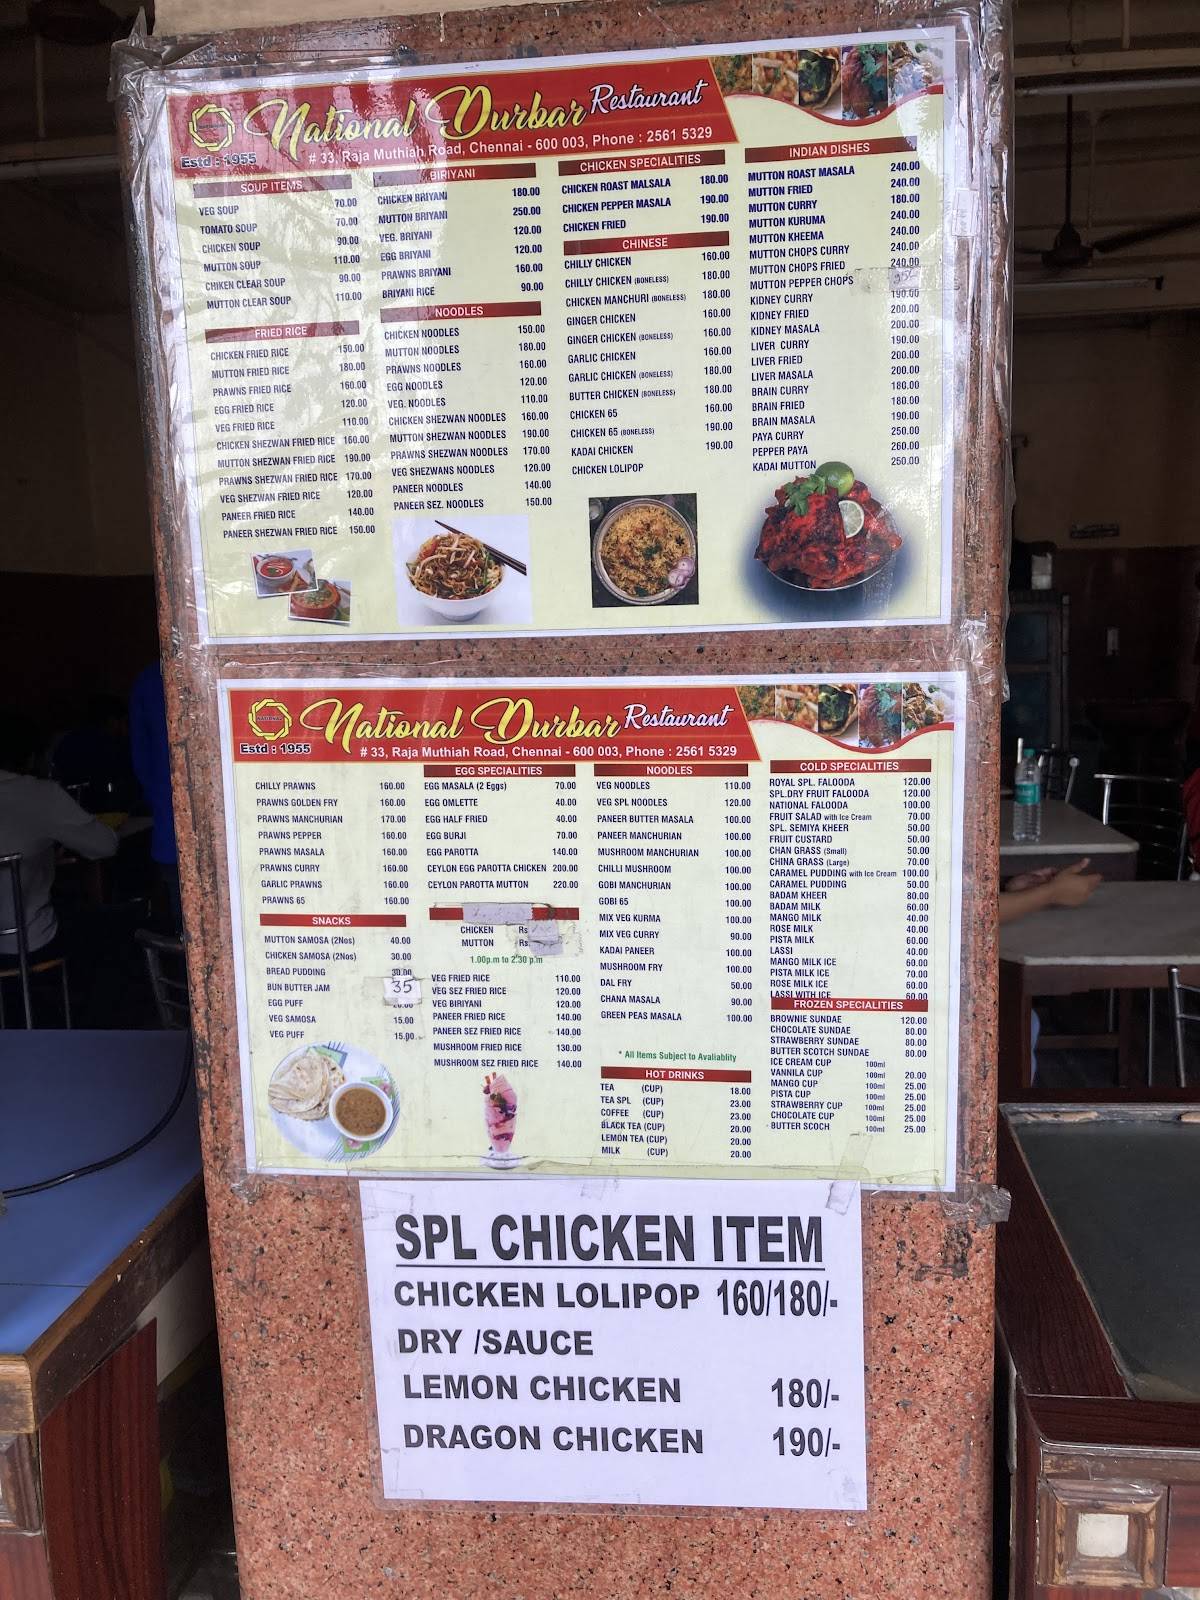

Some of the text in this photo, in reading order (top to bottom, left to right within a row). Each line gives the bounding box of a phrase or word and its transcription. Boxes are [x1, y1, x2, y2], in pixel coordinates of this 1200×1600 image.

[244, 79, 708, 162] National Durbar Restaurant
[309, 152, 316, 163] #
[320, 151, 340, 165] 33,
[342, 150, 369, 164] Raja
[374, 146, 424, 161] Muthiah
[428, 142, 465, 158] Road,
[469, 139, 522, 153] Chennai
[535, 137, 557, 150] 600
[561, 135, 588, 148] 003,
[592, 133, 634, 146] Phone
[646, 128, 675, 142] 2561
[681, 126, 712, 139] 5329
[789, 142, 870, 157] INDIAN DISHES
[181, 153, 257, 168] Estd 1955
[580, 153, 700, 172] CHICKEN SPECIALITIES
[430, 168, 476, 181] BIRIYANI
[747, 160, 920, 181] MUTTON ROAST MASALA 240.00
[240, 179, 303, 193] SOUP ITEMS
[561, 173, 728, 194] CHICKEN ROAST MALSALA 180.00
[378, 206, 540, 224] MUTTON BRIYANI 250.00
[622, 237, 668, 249] CHINESE
[203, 254, 360, 272] MUTTON SOUP 110.00
[564, 250, 729, 269] CHILLY CHICKEN 160.00
[434, 305, 484, 317] NOODLES
[255, 325, 307, 337] FRIED RICE
[384, 324, 545, 340] CHICKEN NOODLES 150.00
[569, 383, 732, 400] BUTTER CHICKEN (BONELESS) 180.00
[571, 440, 733, 456] KADAI CHICKEN 190.00
[752, 440, 919, 456] PEPPER PAYA 260.00
[391, 462, 550, 476] VEG SHEZWANS NOODLES 120.00
[223, 524, 375, 538] PANEER SHEZWAN FRIED RICE 150.00
[300, 697, 735, 753] National Durbar Restaurant
[240, 743, 268, 754] Estd
[280, 743, 311, 754] 1955
[360, 746, 367, 756] #
[370, 746, 388, 758] 33,
[391, 746, 418, 759] Raja
[421, 746, 469, 757] Muthiah
[473, 746, 508, 758] Road,
[511, 746, 561, 756] Chennai
[572, 745, 594, 756] 600
[597, 745, 621, 758] 003,
[625, 745, 664, 756] Phone
[675, 745, 703, 756] 2561
[708, 745, 737, 756] 5329
[455, 766, 542, 775] EGG SPECIALITIES
[646, 765, 692, 774] NOODLES
[799, 761, 898, 771] COLD SPECIALITIES
[255, 781, 404, 790] CHILLY PRAWNS 160.00
[424, 781, 576, 791] EGG MASALA (2 Eggs) 70.00
[596, 781, 750, 789] VEG NOODLES 110.00
[769, 777, 930, 786] ROYAL SPL. FALOODA 120.00
[312, 916, 351, 925] SNACKS
[264, 935, 410, 945] MUTTON SAMOSA (2Nos) 40.00
[793, 999, 903, 1009] FROZEN SPECIALITIES
[770, 1014, 927, 1024] BROWNIE SUNDAE 120.00
[433, 1042, 581, 1051] MUSHROOM FRIED RICE 130.00
[624, 1050, 736, 1062] All Items Subject to Avaliablity
[645, 1069, 704, 1079] HOT DRINKS
[770, 1068, 804, 1076] VANNILA
[806, 1068, 822, 1077] CUP
[904, 1071, 926, 1079] 20.00
[600, 1108, 751, 1120] COFFEE (CUP) 23.00
[395, 1213, 822, 1262] SPL CHICKEN ITEM
[394, 1279, 838, 1316] CHICKEN LOLIPOP 160/180/-
[397, 1328, 462, 1353] DRY
[403, 1374, 840, 1408] LEMON CHICKEN 180/-
[403, 1424, 841, 1457] DRAGON CHICKEN 190/-
